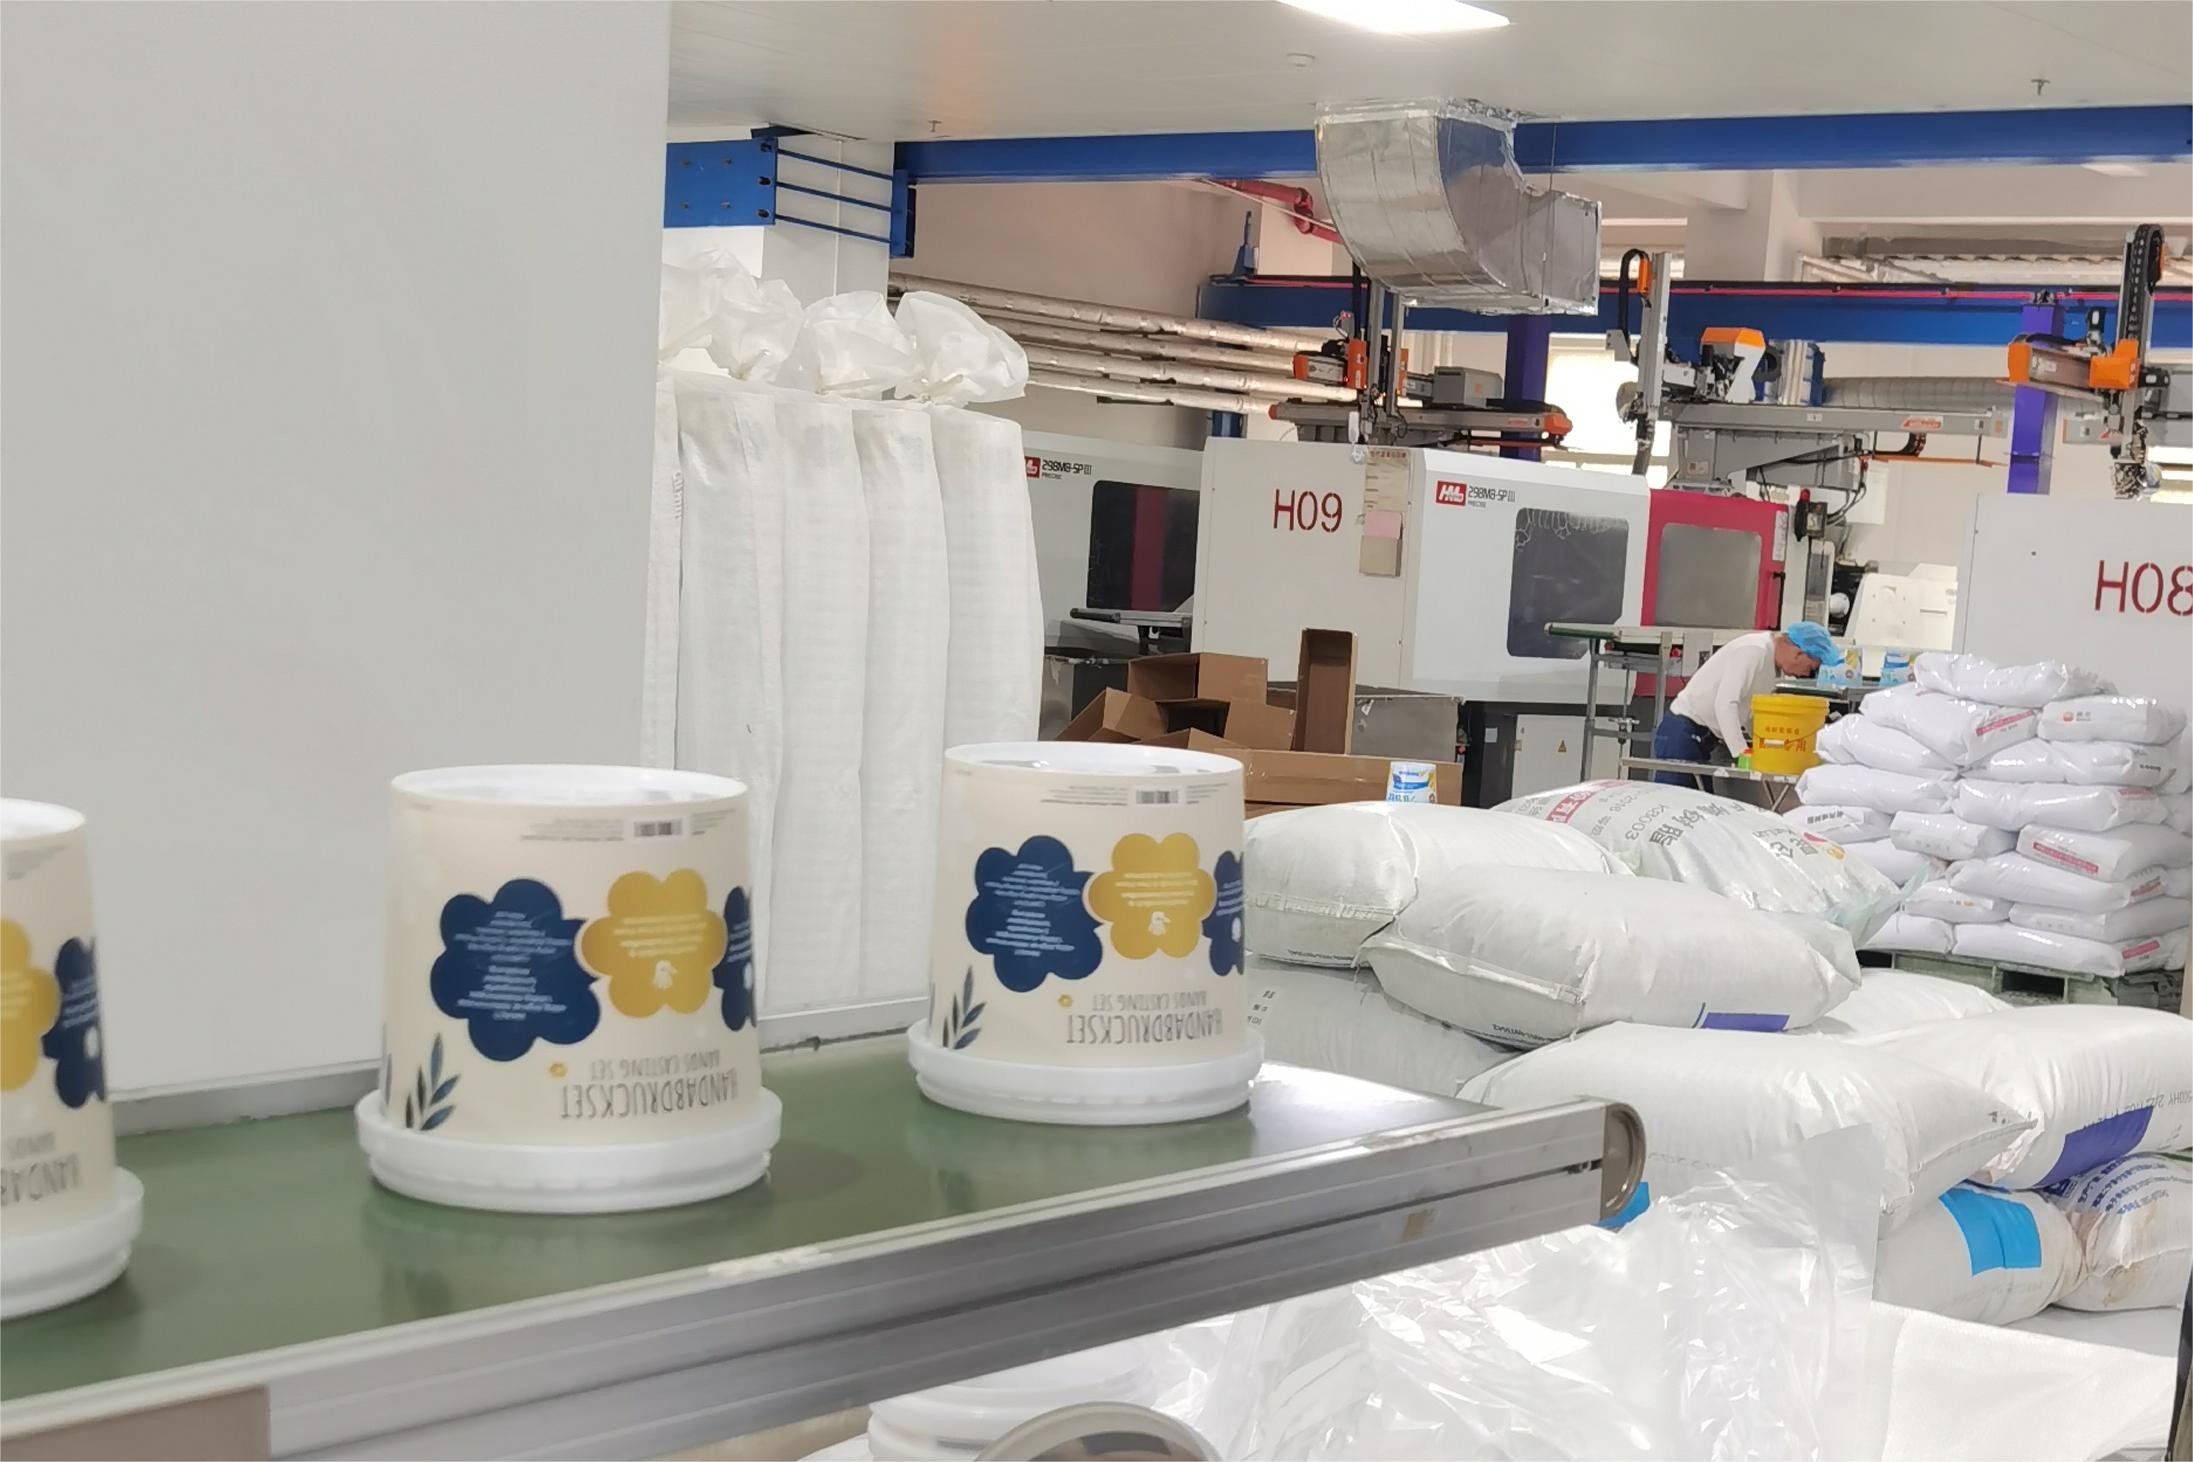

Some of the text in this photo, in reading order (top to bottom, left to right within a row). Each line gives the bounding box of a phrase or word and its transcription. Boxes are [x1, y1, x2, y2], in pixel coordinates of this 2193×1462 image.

[1273, 488, 1343, 533] H09
[2095, 559, 2193, 617] H08
[1092, 994, 1114, 1012] SET
[1118, 993, 1171, 1012] CASTING
[1066, 1008, 1223, 1045] HANDABDRUCKSET
[590, 1060, 616, 1082] SET
[618, 1054, 681, 1079] CASTING
[561, 1067, 740, 1120] HANDABDRUCKSET
